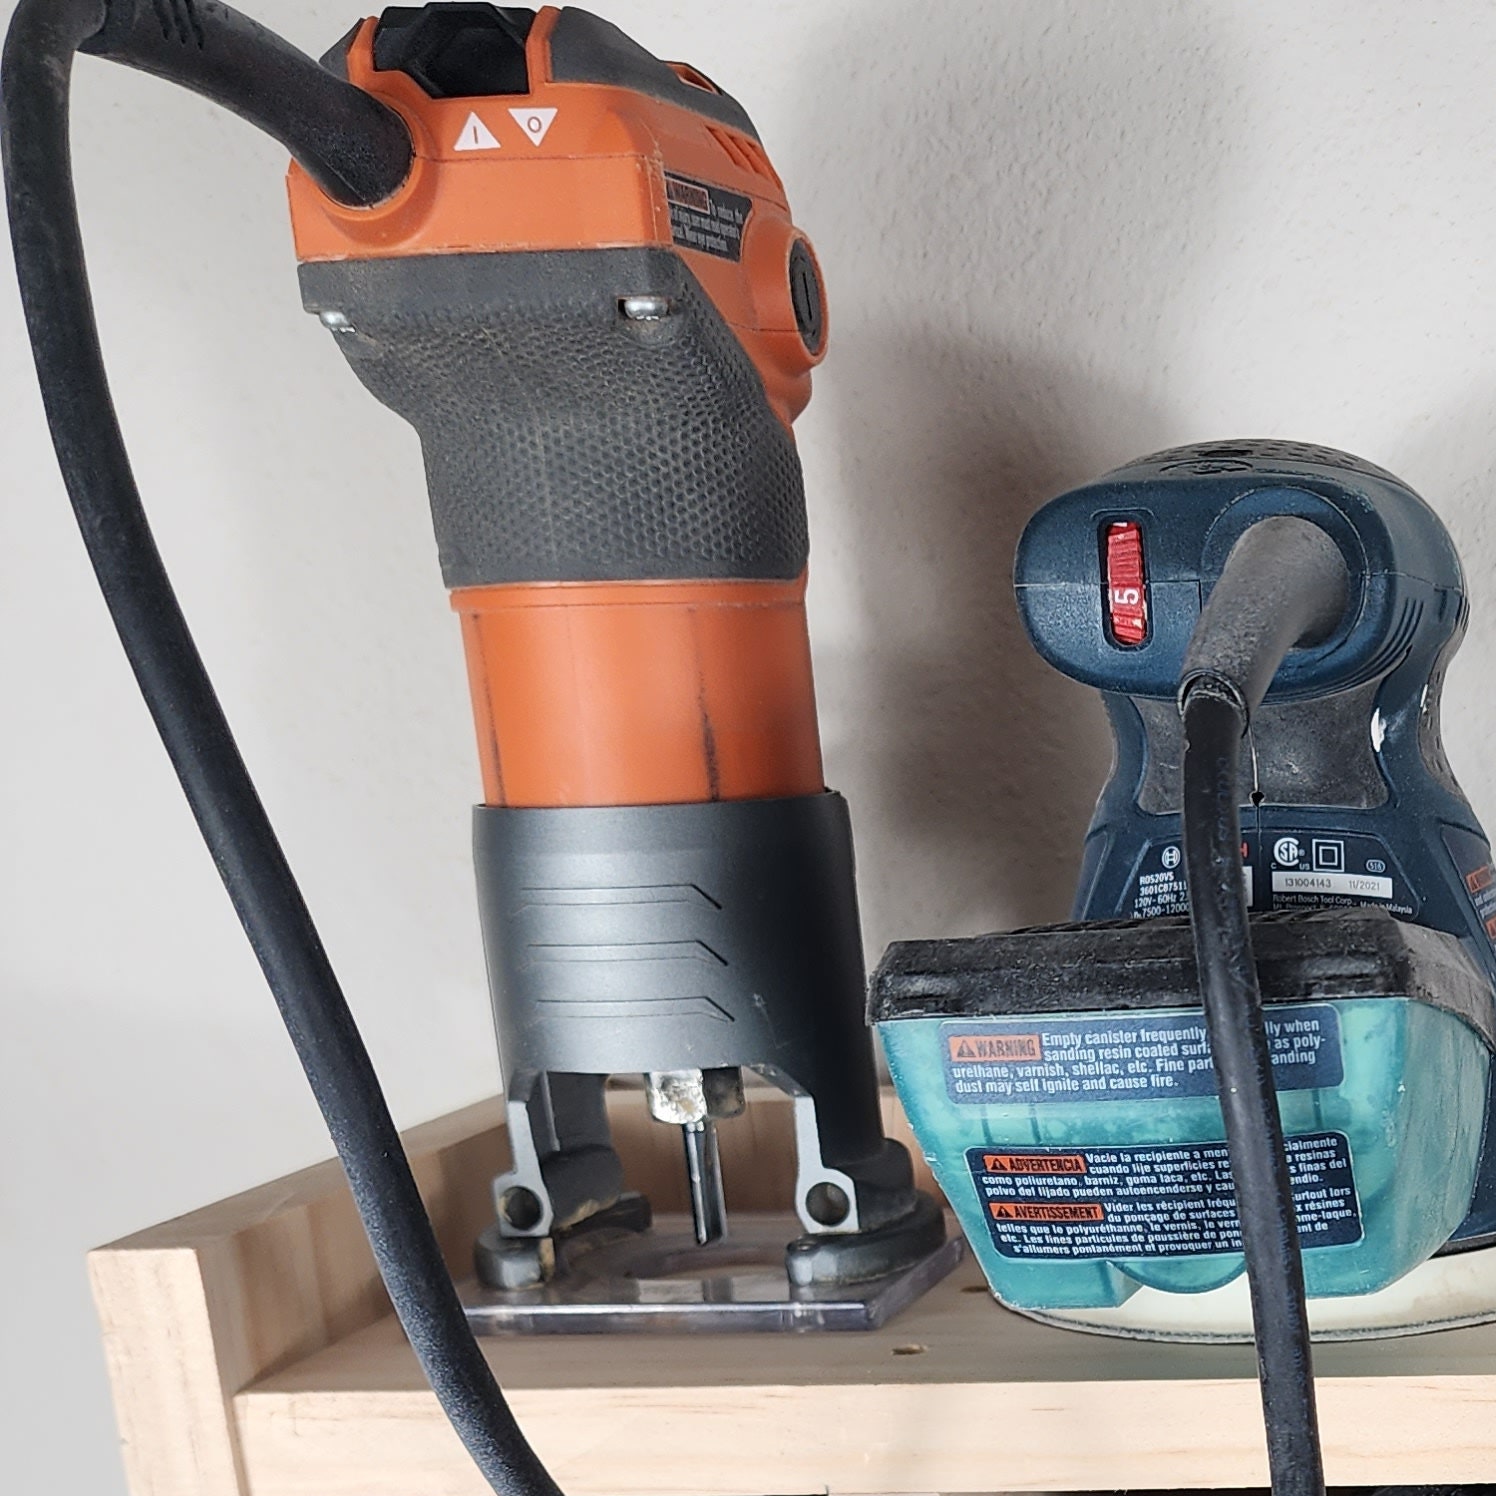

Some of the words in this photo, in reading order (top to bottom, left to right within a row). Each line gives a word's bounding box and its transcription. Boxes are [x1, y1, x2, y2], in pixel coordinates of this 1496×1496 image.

[1114, 587, 1140, 605] 5
[1285, 878, 1332, 889] 131004143
[1042, 1032, 1082, 1050] Empty
[1085, 1029, 1138, 1046] canister
[1140, 1025, 1207, 1043] frequently
[1284, 1019, 1320, 1033] when
[975, 1039, 1036, 1059] WARNING
[1044, 1046, 1095, 1064] sanding
[1099, 1044, 1131, 1061] resin
[1135, 1041, 1179, 1058] coated
[1181, 1042, 1211, 1057] surf
[1274, 1038, 1290, 1050] as
[1293, 1033, 1326, 1052] poly-
[952, 1064, 1014, 1080] urethane,
[1072, 1060, 1124, 1077] shellac,
[1127, 1057, 1153, 1073] etc.
[1156, 1056, 1184, 1073] Fine
[1271, 1050, 1317, 1066] anding
[955, 1079, 983, 1094] dust
[985, 1078, 1013, 1096] may
[1014, 1076, 1039, 1092] self
[1082, 1074, 1107, 1090] and
[1109, 1074, 1148, 1090] cause
[1149, 1073, 1179, 1088] fire.
[1008, 1157, 1083, 1172] ADVERTENCIA
[1088, 1163, 1130, 1175] cuando
[1153, 1160, 1216, 1174] superficies
[1294, 1149, 1336, 1162] resinas
[1134, 1149, 1191, 1164] recipiente
[1192, 1150, 1201, 1159] a
[1203, 1148, 1229, 1159] men
[981, 1175, 1013, 1186] como
[1126, 1175, 1158, 1187] goma
[1298, 1161, 1327, 1173] finas
[1328, 1157, 1348, 1169] del
[984, 1186, 1016, 1198] polvo
[1018, 1186, 1036, 1197] del
[1037, 1186, 1071, 1199] lijado
[1072, 1187, 1114, 1199] pueden
[1116, 1183, 1204, 1197] autoencenderse
[1205, 1184, 1213, 1194] y
[1214, 1181, 1236, 1192] cau
[1103, 1202, 1134, 1213] Vider
[1135, 1201, 1155, 1212] les
[1156, 1199, 1205, 1214] récipient
[1293, 1187, 1328, 1202] urtout
[1329, 1186, 1352, 1197] lors
[1013, 1205, 1099, 1219] AVERTISSEMENT
[1107, 1213, 1122, 1223] du
[1123, 1212, 1171, 1225] ponçage
[1172, 1210, 1187, 1221] de
[1188, 1208, 1236, 1221] surfaces
[1304, 1198, 1346, 1212] résines
[996, 1222, 1029, 1234] telles
[1029, 1224, 1051, 1236] que
[1052, 1223, 1064, 1234] le
[1149, 1222, 1161, 1232] le
[1203, 1219, 1216, 1230] le
[1023, 1234, 1044, 1245] Les
[1045, 1234, 1073, 1245] fines
[1074, 1234, 1129, 1246] particules
[1130, 1233, 1145, 1243] de
[1147, 1230, 1201, 1245] poussière
[1202, 1229, 1217, 1240] de
[1313, 1220, 1329, 1231] de
[1144, 1243, 1157, 1252] et
[1157, 1241, 1213, 1254] provoquer
[1214, 1240, 1230, 1250] un
